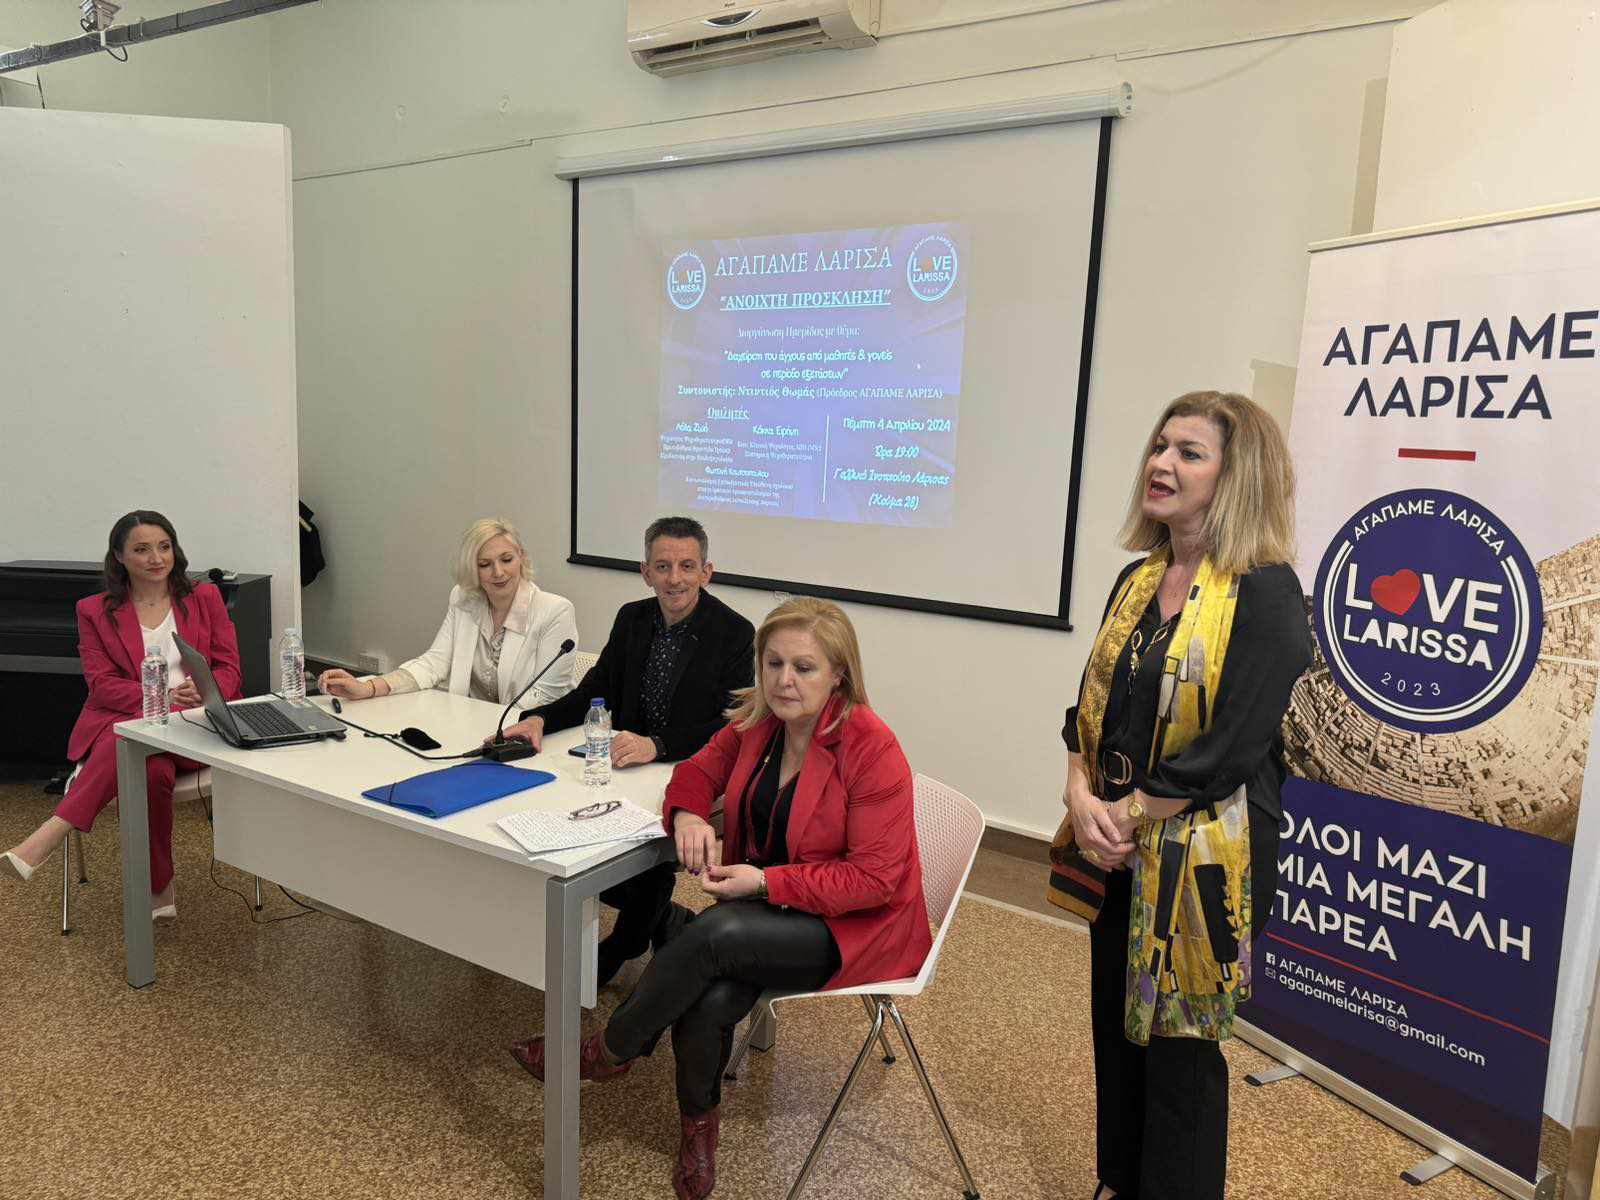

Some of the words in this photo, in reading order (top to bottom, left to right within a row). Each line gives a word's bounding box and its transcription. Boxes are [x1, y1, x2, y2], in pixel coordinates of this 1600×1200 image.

[713, 252, 808, 277] ΑΓΑΠΑΜΕ
[814, 246, 893, 272] ΛΑΡΙΣΑ
[1323, 310, 1600, 366] ΑΓΑΠΑΜΕ
[877, 417, 885, 430] 4
[1343, 374, 1553, 420] ΛΑΡΙΣΑ
[1352, 500, 1436, 541] ΑΓΑΠΑΜΕ
[1440, 504, 1506, 556] ΛΑΡΙΣΑ
[1343, 614, 1494, 671] LARISSA
[1381, 672, 1441, 697] 2023
[1377, 836, 1487, 899] ΜΑΖΙ
[1270, 889, 1398, 962] ΠΑΡΕΑ
[1277, 853, 1333, 896] ΜΙΑ
[1347, 871, 1531, 962] ΜΕΓΑΛΗ
[1279, 957, 1346, 994] ΑΓΑΠΑΜΕ
[1350, 987, 1409, 1019] ΛΑΡΙΣΑ
[1279, 974, 1486, 1067] agapamelarisa@gmail.com
